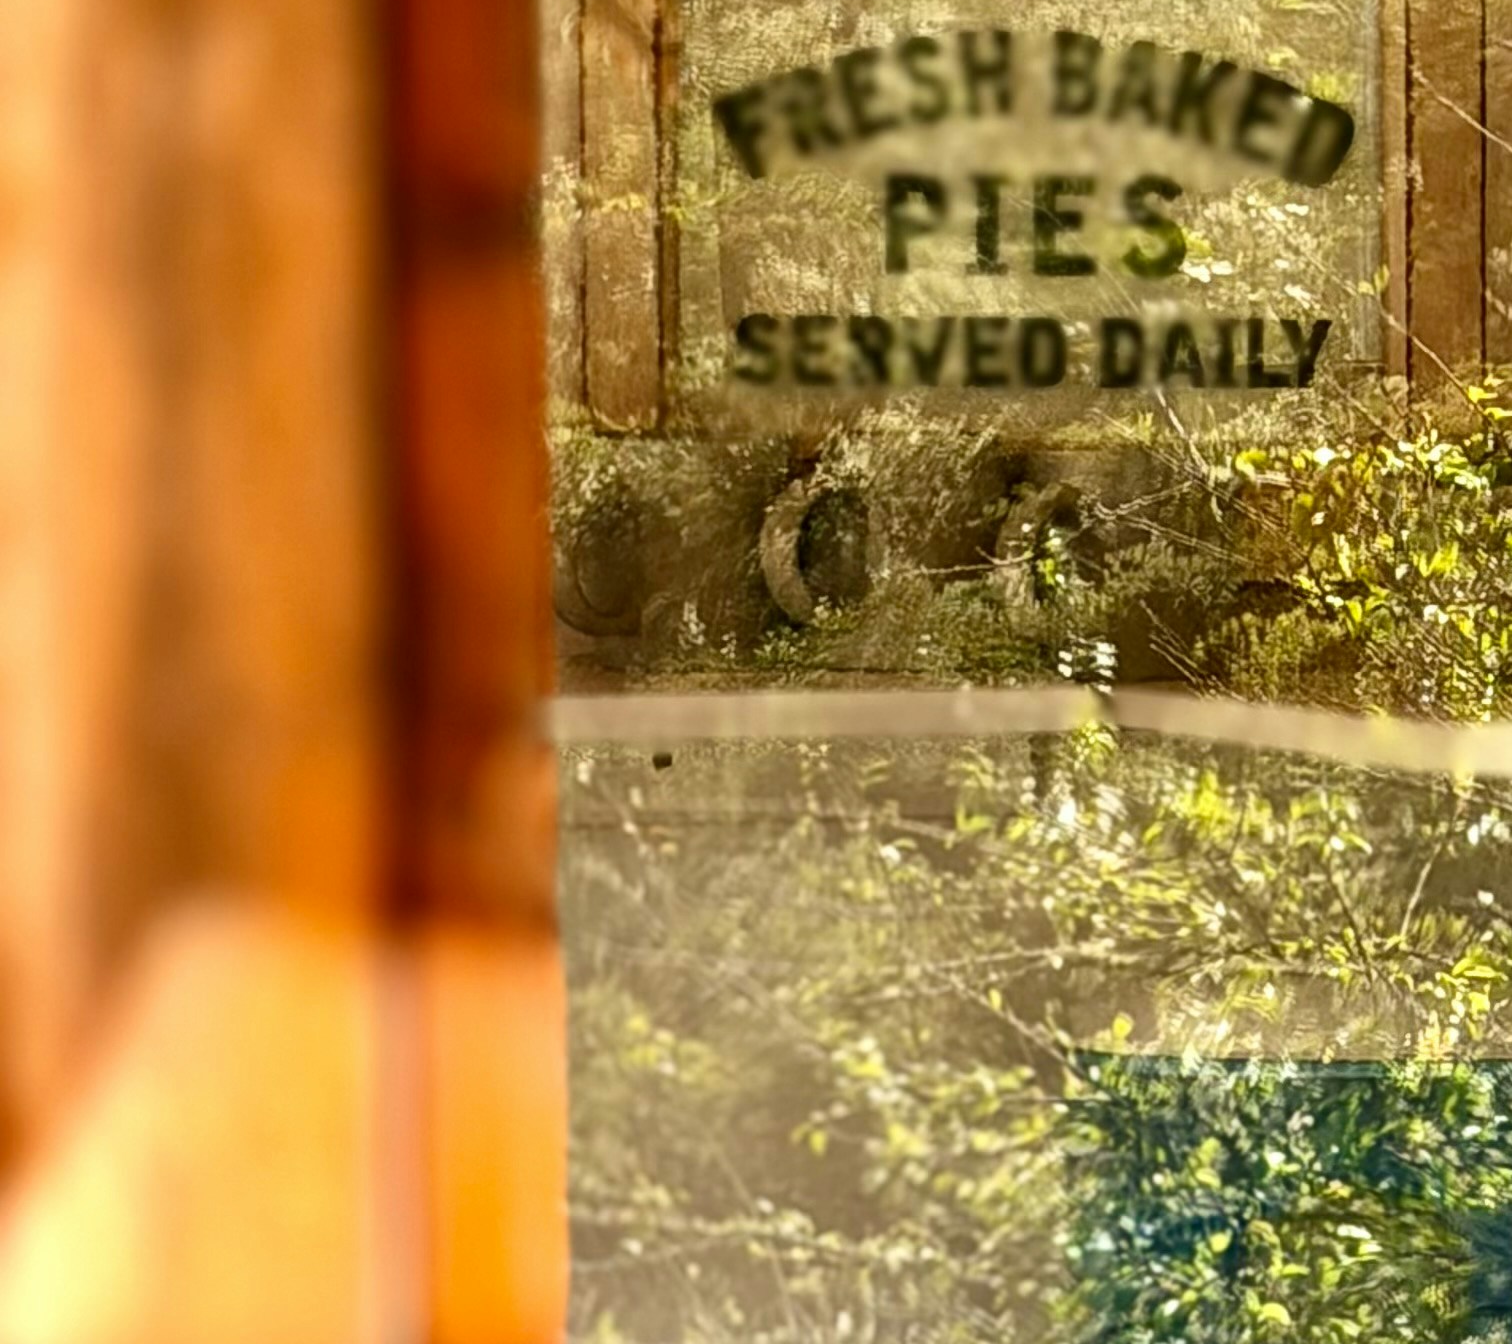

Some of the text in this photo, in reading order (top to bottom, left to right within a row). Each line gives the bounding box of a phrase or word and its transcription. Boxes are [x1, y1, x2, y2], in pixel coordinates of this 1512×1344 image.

[713, 30, 1355, 188] FRESH BAKED
[884, 173, 1188, 278] PIES
[734, 314, 1332, 389] SERVED DAILY
